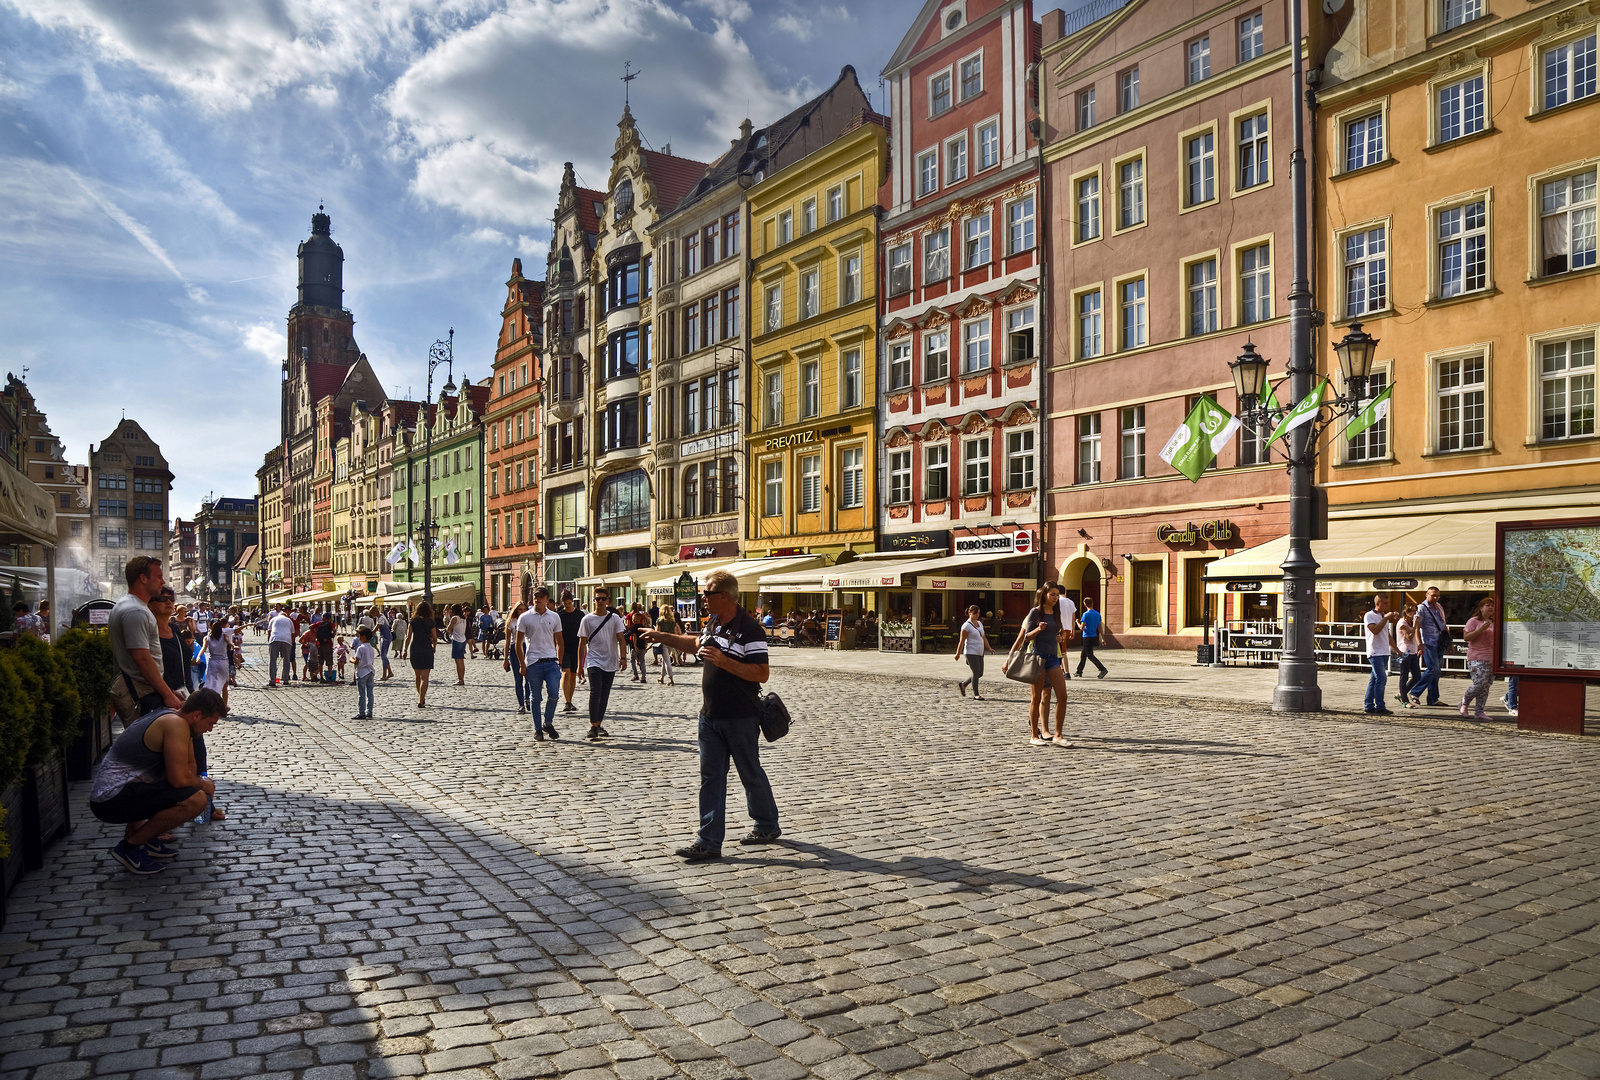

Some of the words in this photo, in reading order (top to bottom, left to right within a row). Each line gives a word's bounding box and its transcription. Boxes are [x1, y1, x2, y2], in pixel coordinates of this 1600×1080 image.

[1156, 522, 1196, 546] Candy
[1200, 519, 1232, 542] Club
[956, 540, 980, 551] KOBO
[981, 538, 1011, 549] SUSHI
